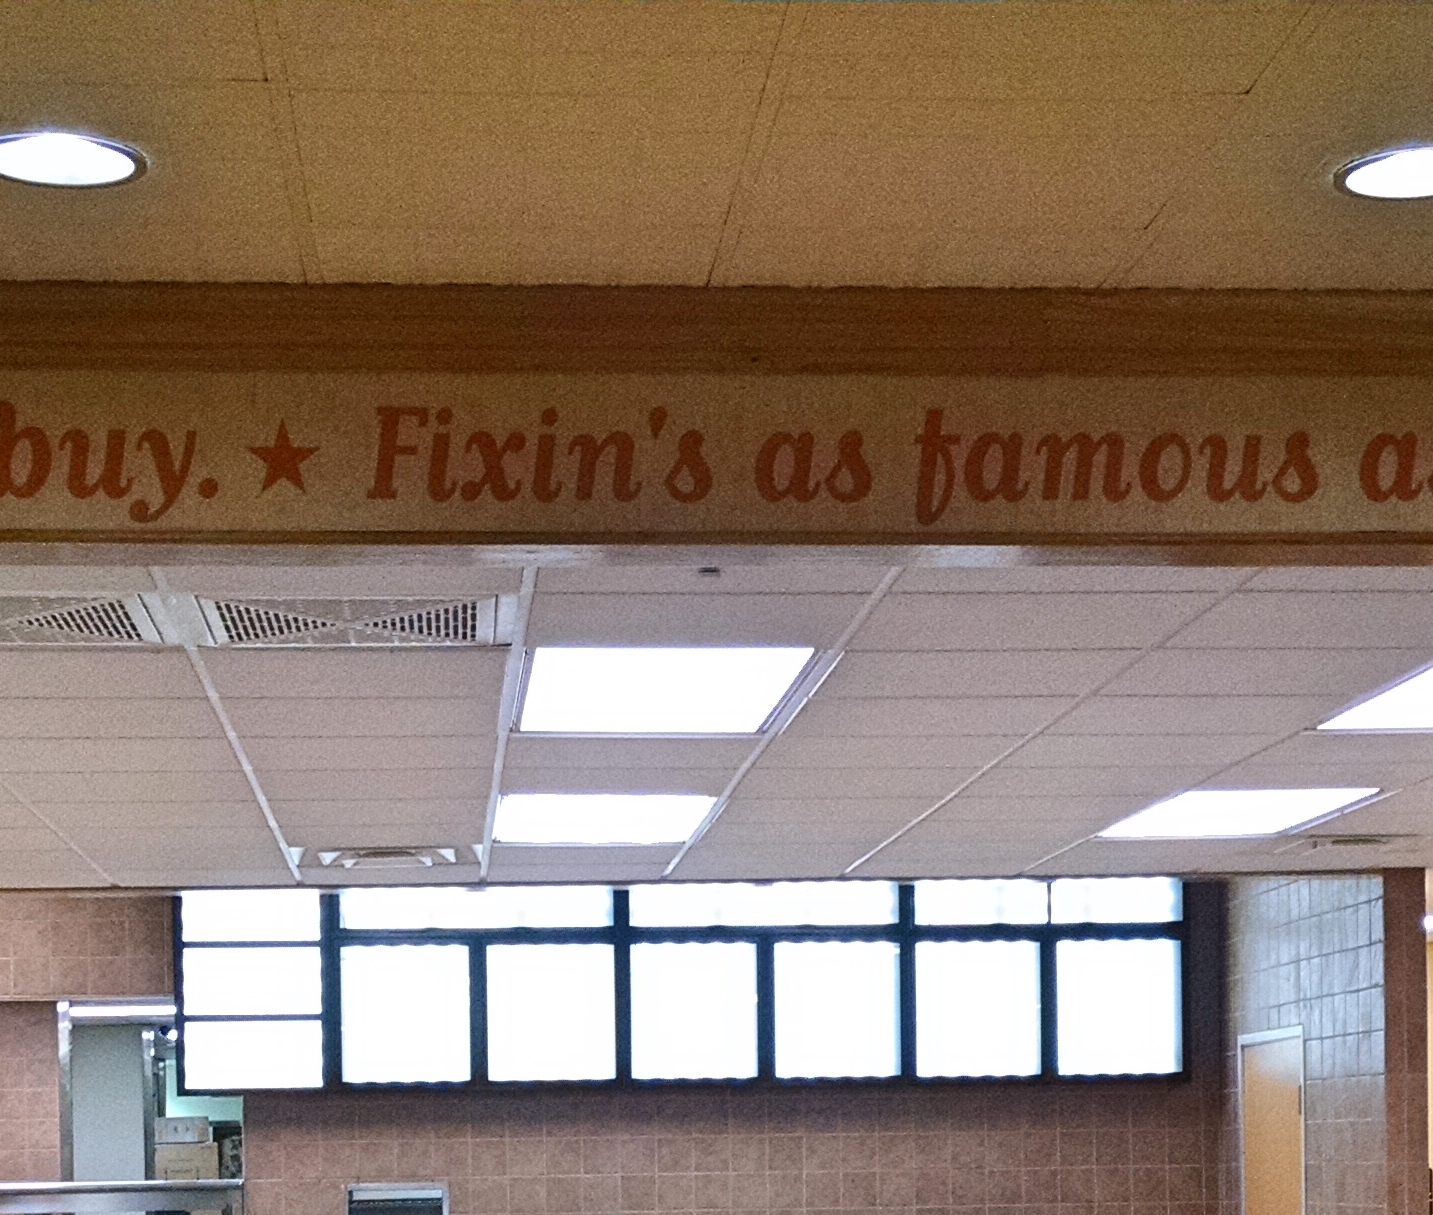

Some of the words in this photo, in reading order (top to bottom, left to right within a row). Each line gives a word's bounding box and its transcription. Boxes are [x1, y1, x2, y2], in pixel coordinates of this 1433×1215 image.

[367, 405, 714, 502] Fixin's
[755, 429, 872, 502] as
[913, 408, 1320, 526] famous
[1358, 430, 1433, 502] a
